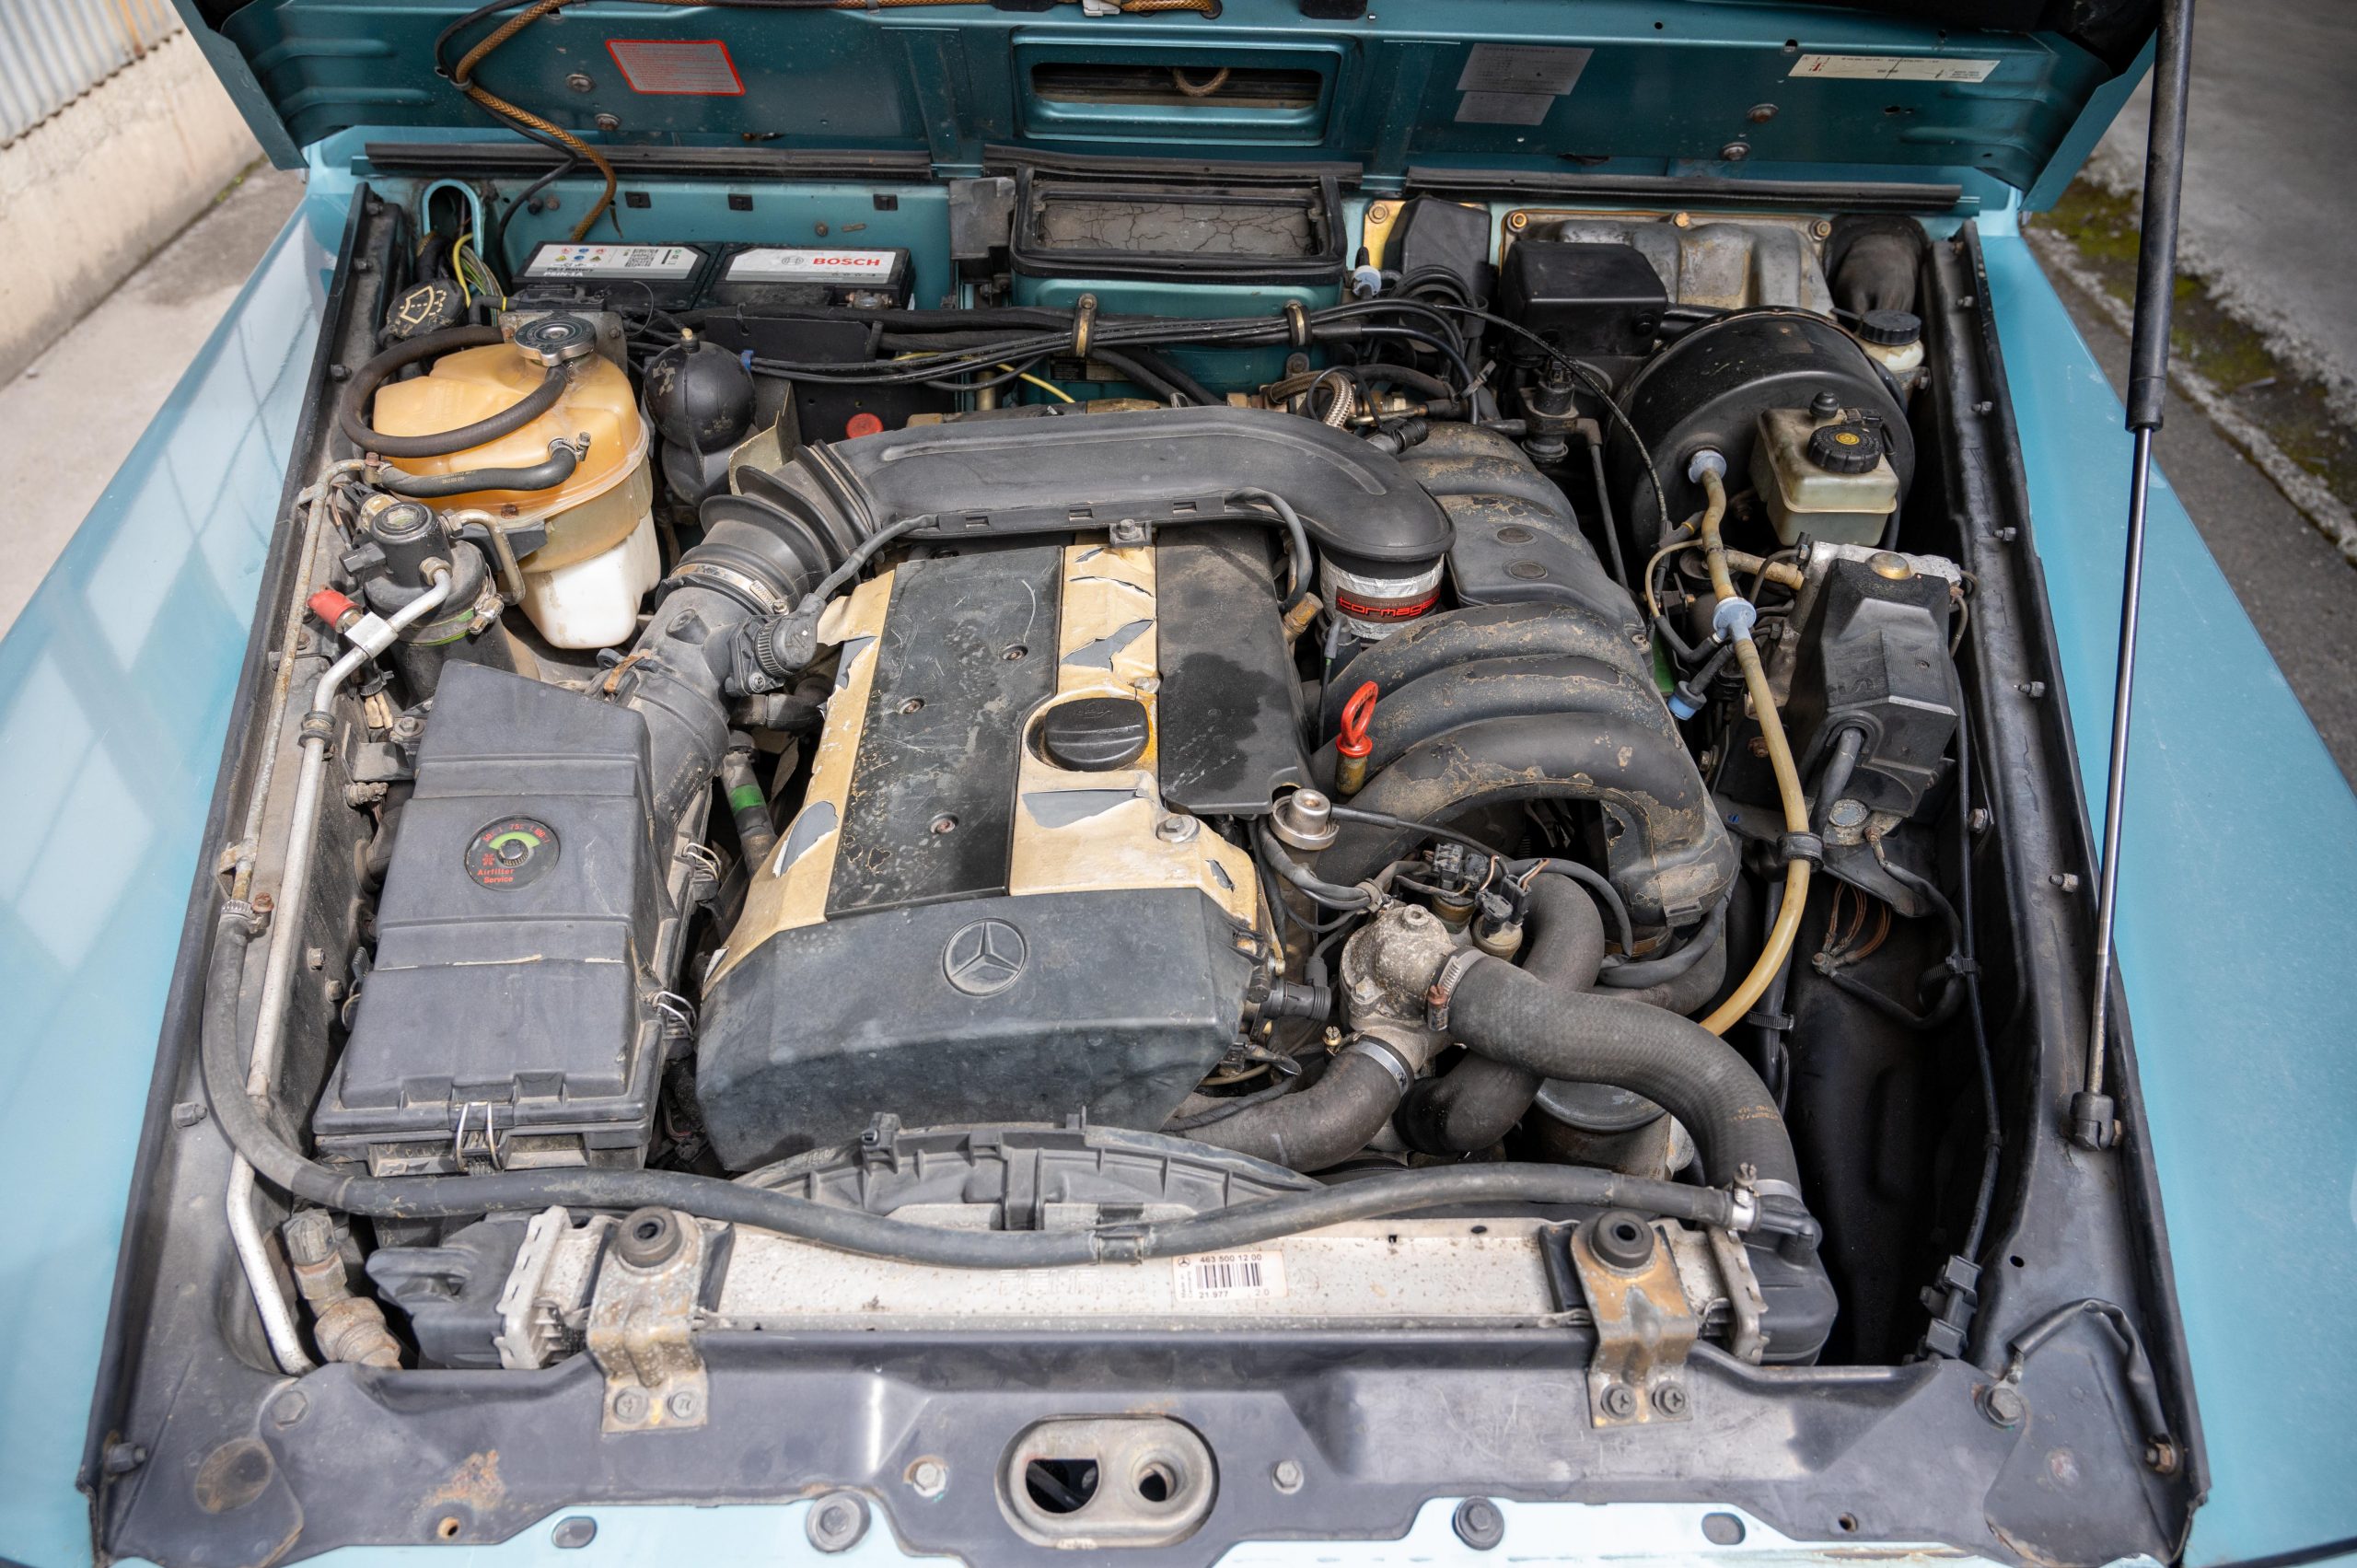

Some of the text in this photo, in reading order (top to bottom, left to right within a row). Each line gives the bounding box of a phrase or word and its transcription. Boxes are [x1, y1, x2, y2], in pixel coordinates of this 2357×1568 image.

[813, 258, 880, 266] BOSCH
[483, 876, 514, 884] Service
[1251, 1253, 1262, 1261] 00
